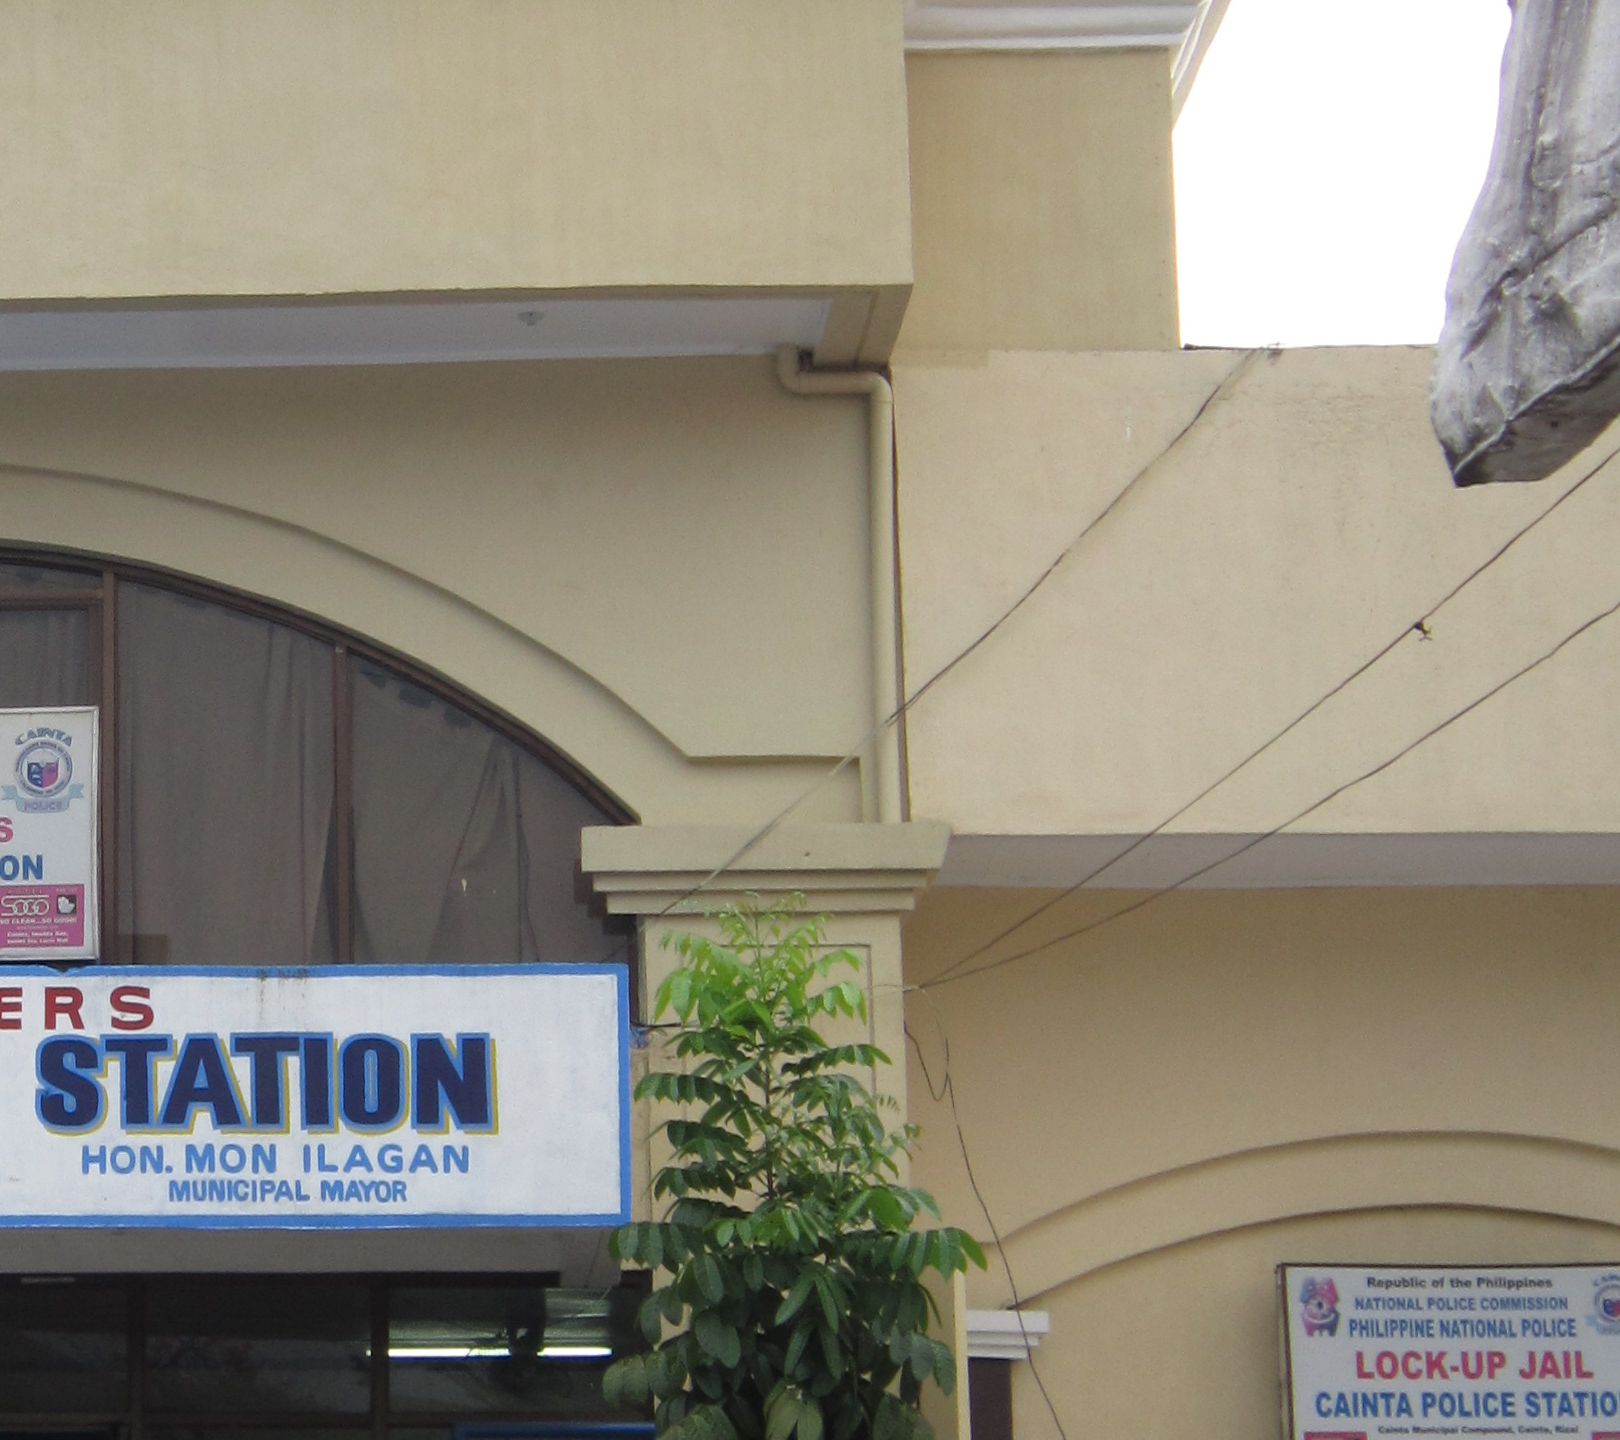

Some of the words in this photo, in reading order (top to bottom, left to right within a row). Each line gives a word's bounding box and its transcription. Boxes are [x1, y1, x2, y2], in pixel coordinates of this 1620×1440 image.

[15, 727, 72, 747] CAINTA
[34, 1032, 499, 1135] STATION
[81, 1144, 172, 1175] HON.
[184, 1144, 278, 1175] MON
[301, 1143, 471, 1175] ILAGAN
[168, 1180, 310, 1203] MUNICIPAL
[320, 1179, 408, 1203] MAYOR
[1367, 1276, 1427, 1291] Republic
[1431, 1276, 1445, 1289] of
[1450, 1276, 1472, 1289] the
[1476, 1275, 1553, 1291] Philippines
[1355, 1297, 1424, 1311] NATIONAL
[1428, 1297, 1476, 1311] POLICE
[1480, 1296, 1568, 1310] COMMISSION
[1349, 1318, 1435, 1339] PHILIPPINE
[1439, 1318, 1517, 1338] NATIONAL
[1521, 1318, 1577, 1338] POLICE
[1355, 1350, 1507, 1380] LOCK-UP
[1519, 1350, 1594, 1380] JAIL
[1315, 1391, 1413, 1419] CAINTA
[1421, 1391, 1517, 1418] POLICE
[1525, 1390, 1620, 1418] STATIO
